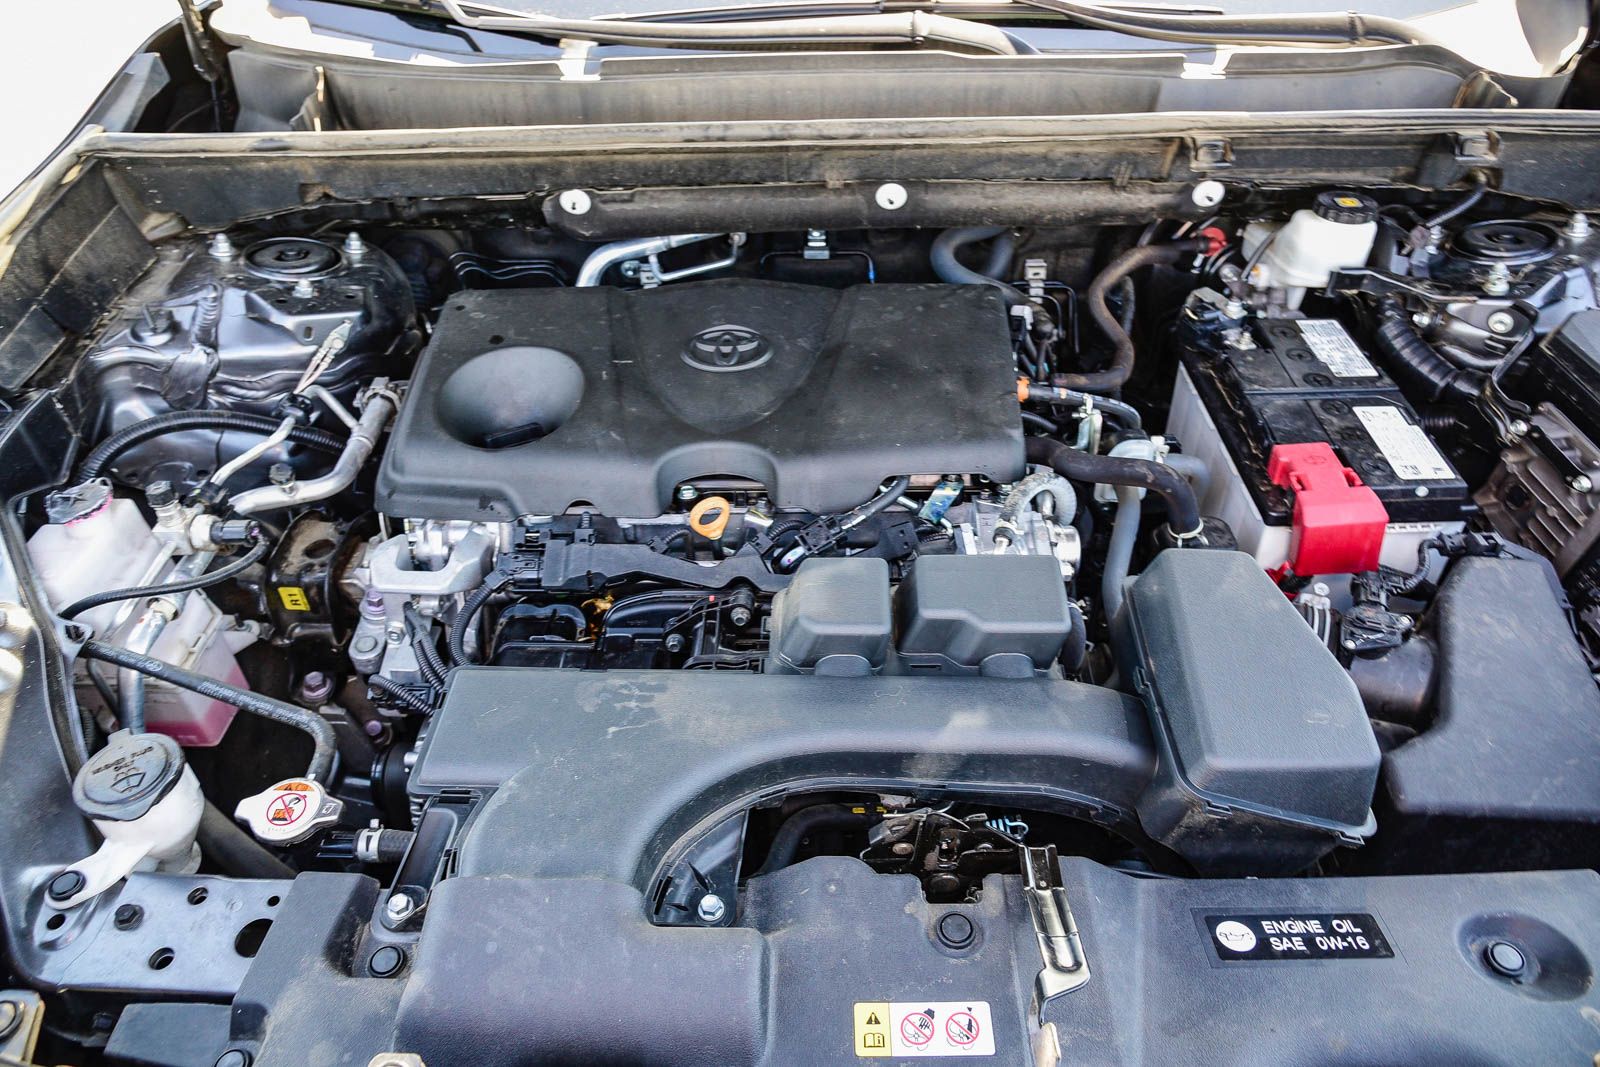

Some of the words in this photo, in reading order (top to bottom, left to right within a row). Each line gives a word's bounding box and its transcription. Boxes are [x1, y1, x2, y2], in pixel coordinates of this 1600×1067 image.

[1261, 919, 1325, 935] ENGINE
[1332, 919, 1363, 934] OIL
[1269, 936, 1307, 952] SAE
[1315, 935, 1370, 951] 0W-16
